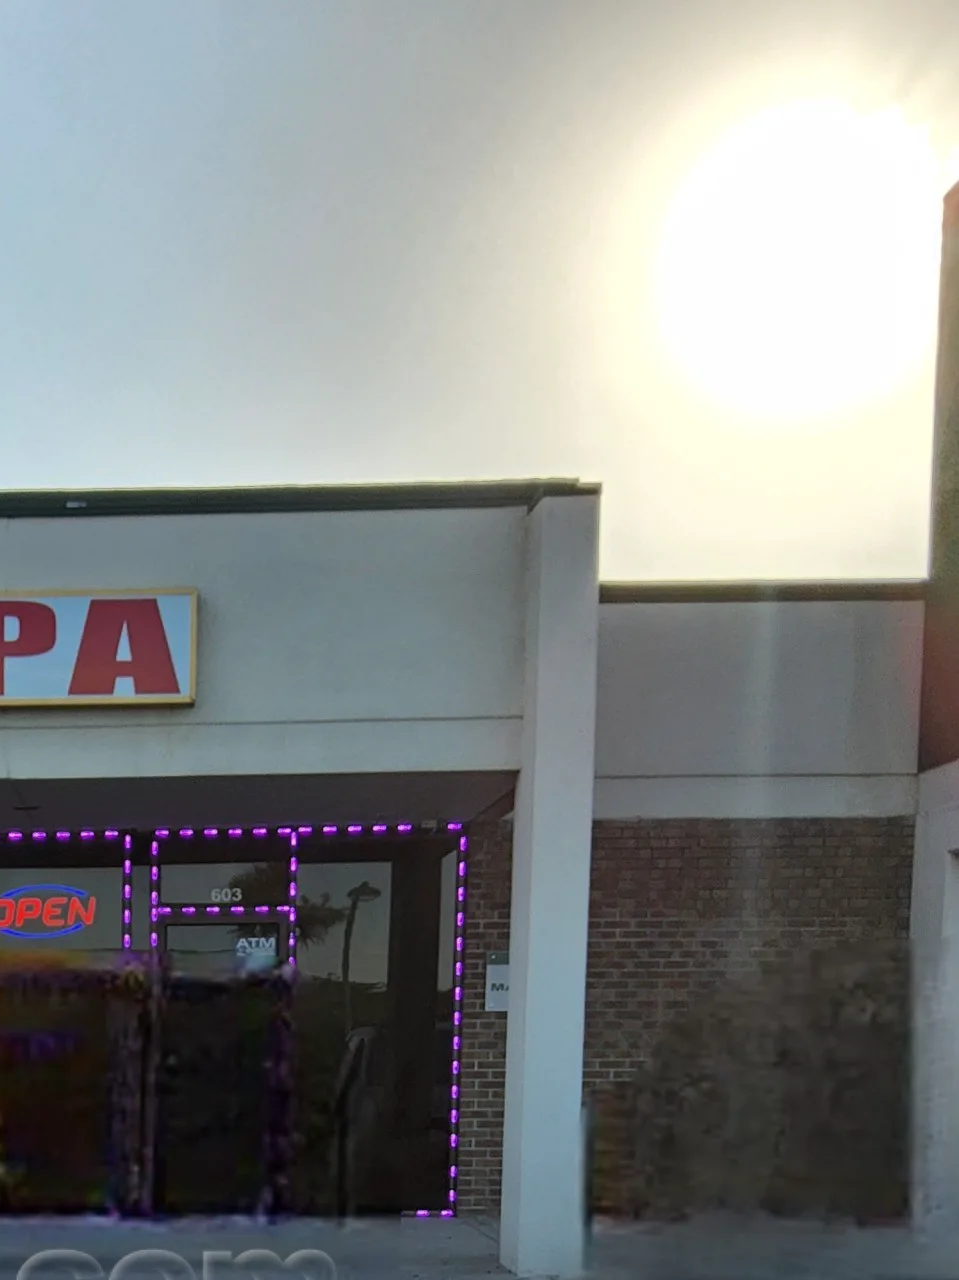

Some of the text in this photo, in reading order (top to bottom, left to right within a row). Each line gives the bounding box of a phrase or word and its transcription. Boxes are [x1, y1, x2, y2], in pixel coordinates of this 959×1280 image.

[210, 888, 242, 902] 603
[236, 937, 276, 949] ATM
[490, 982, 510, 991] M
